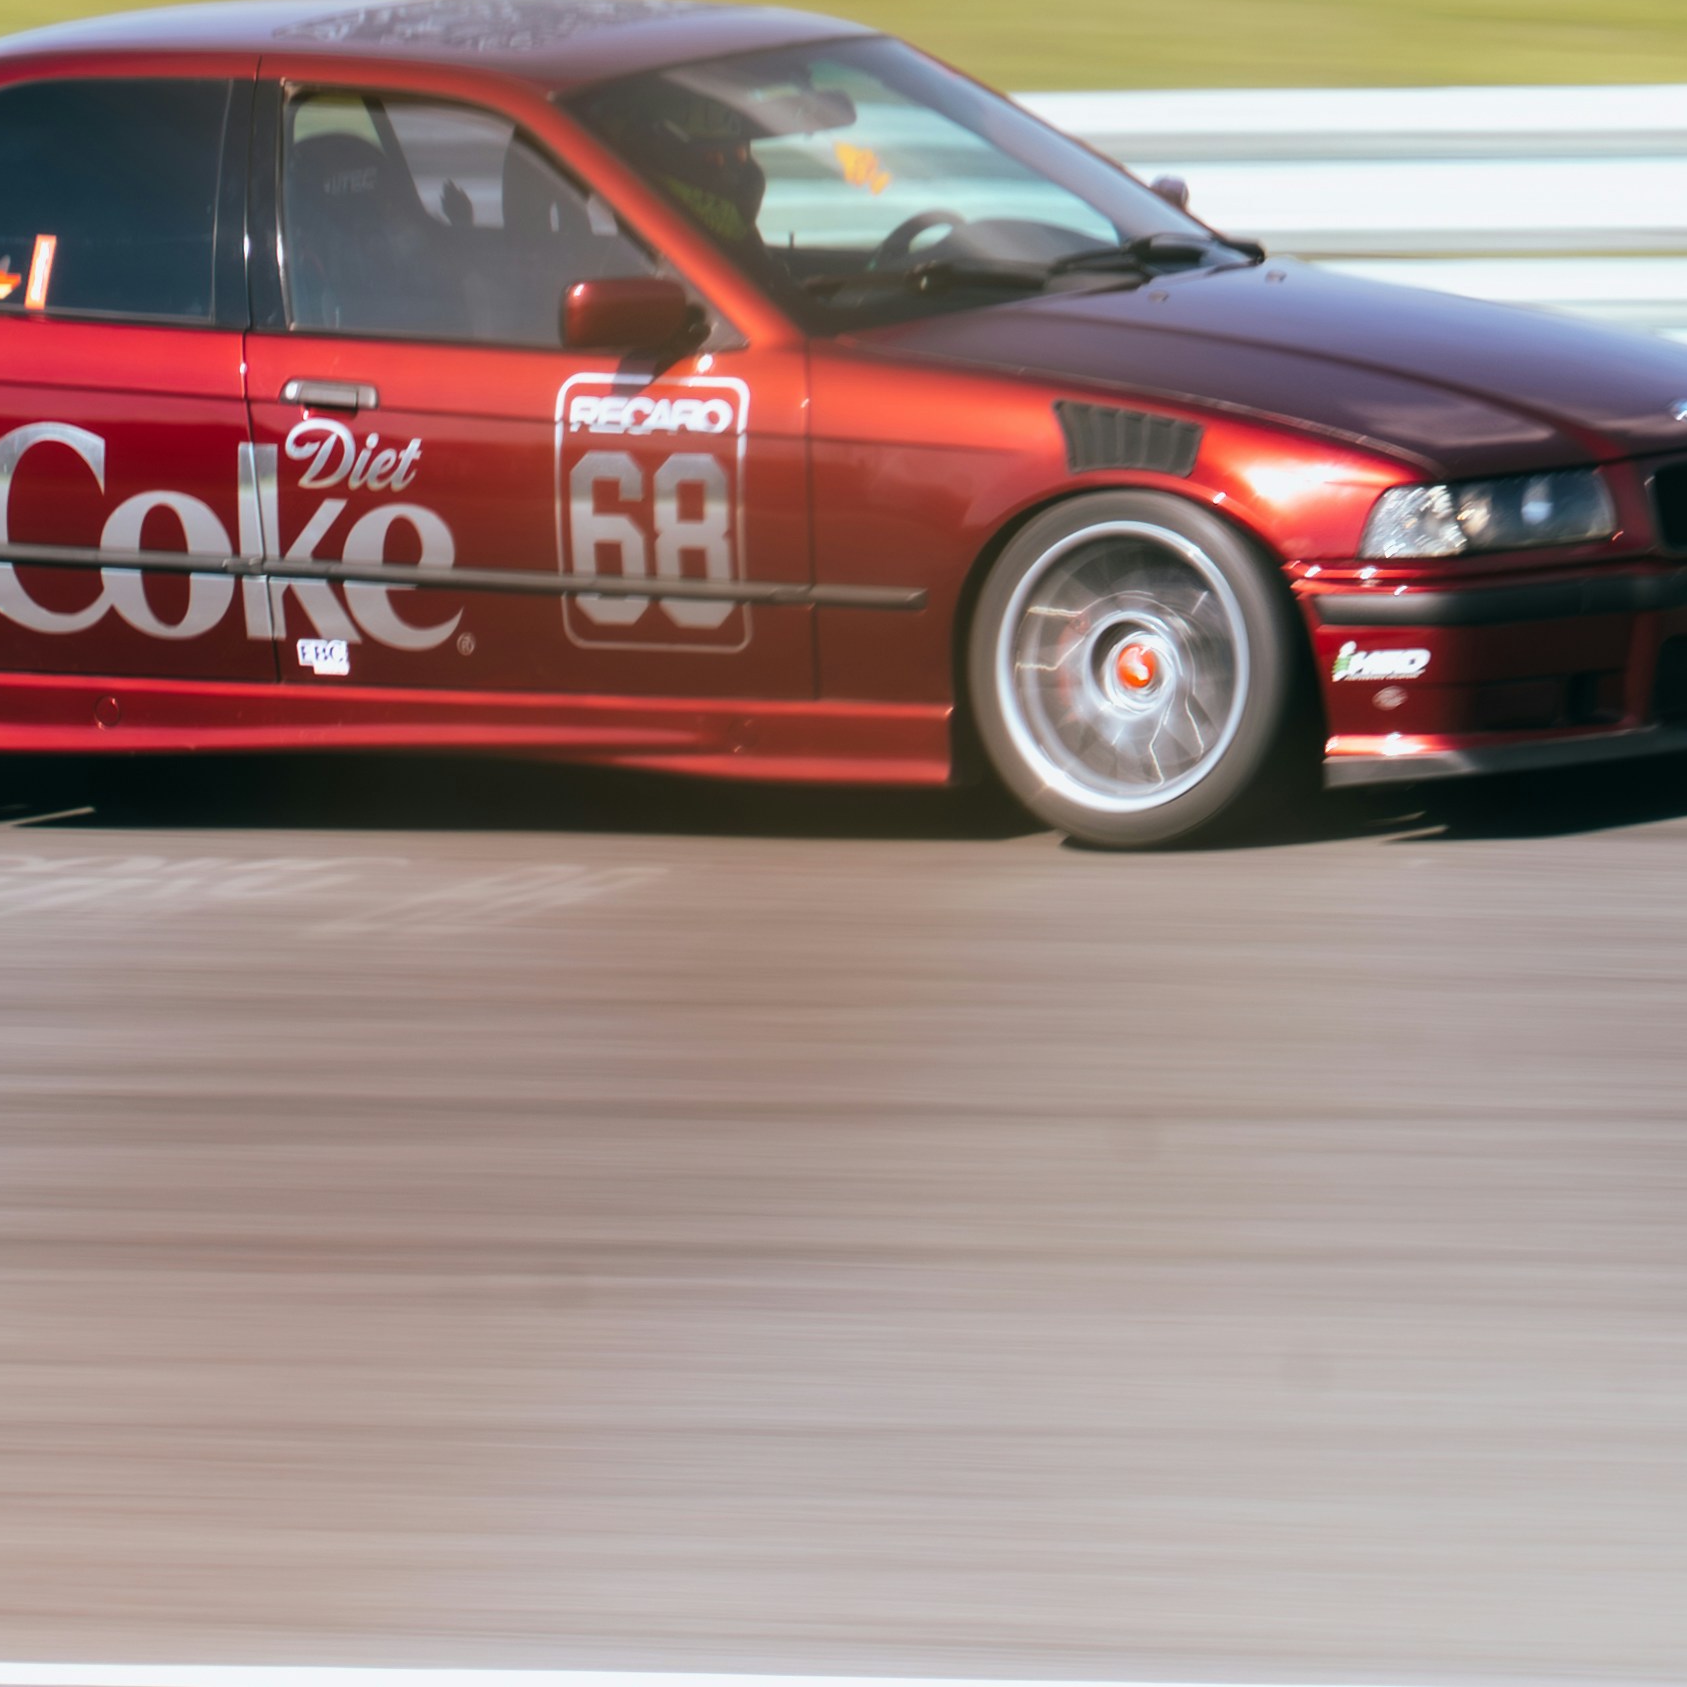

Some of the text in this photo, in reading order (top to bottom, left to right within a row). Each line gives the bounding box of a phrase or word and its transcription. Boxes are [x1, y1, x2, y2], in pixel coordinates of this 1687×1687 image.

[569, 396, 733, 435] RECARO
[285, 418, 422, 490] Diet
[569, 450, 736, 630] 68
